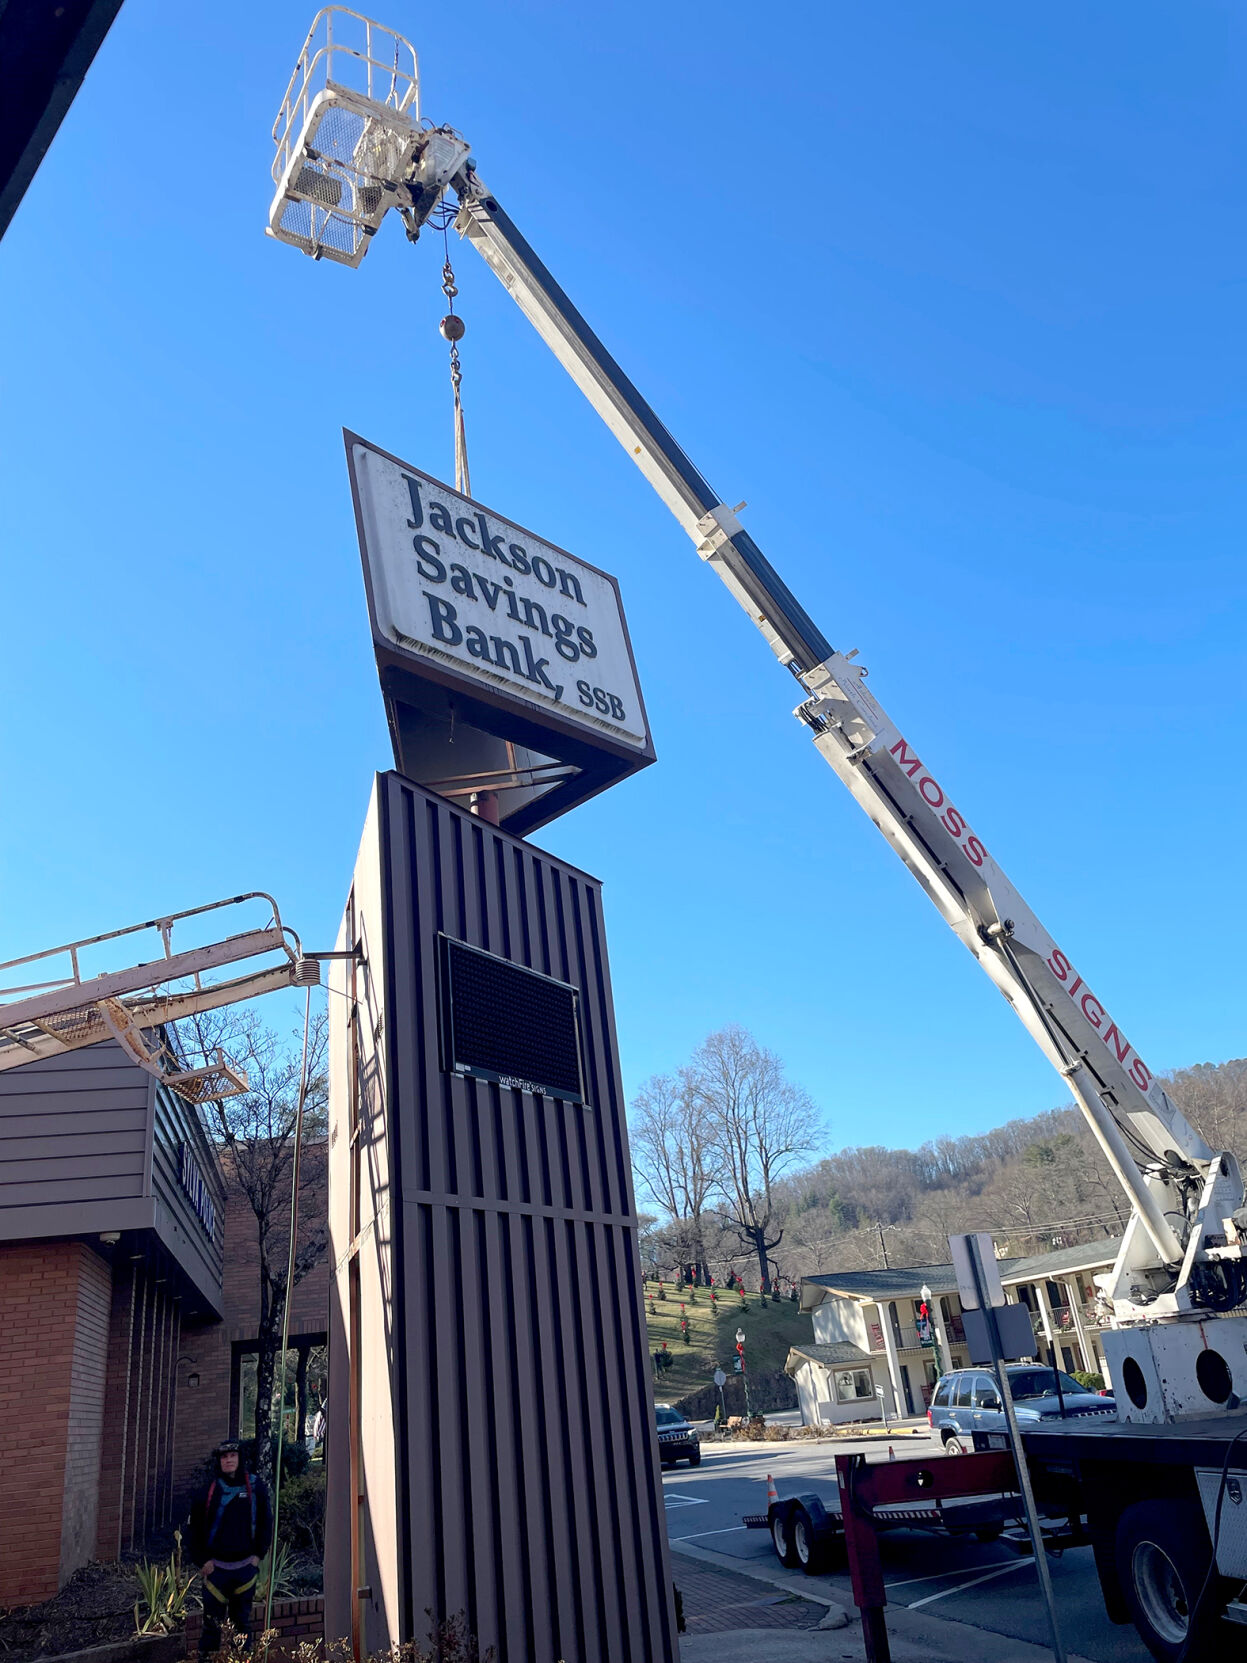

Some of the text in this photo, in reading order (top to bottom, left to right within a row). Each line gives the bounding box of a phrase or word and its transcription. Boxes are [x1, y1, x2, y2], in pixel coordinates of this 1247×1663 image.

[401, 473, 587, 608] Jackson
[413, 534, 598, 662] Savings
[422, 590, 626, 721] Bank, SSB
[889, 738, 1152, 1092] MOSS SIGNS
